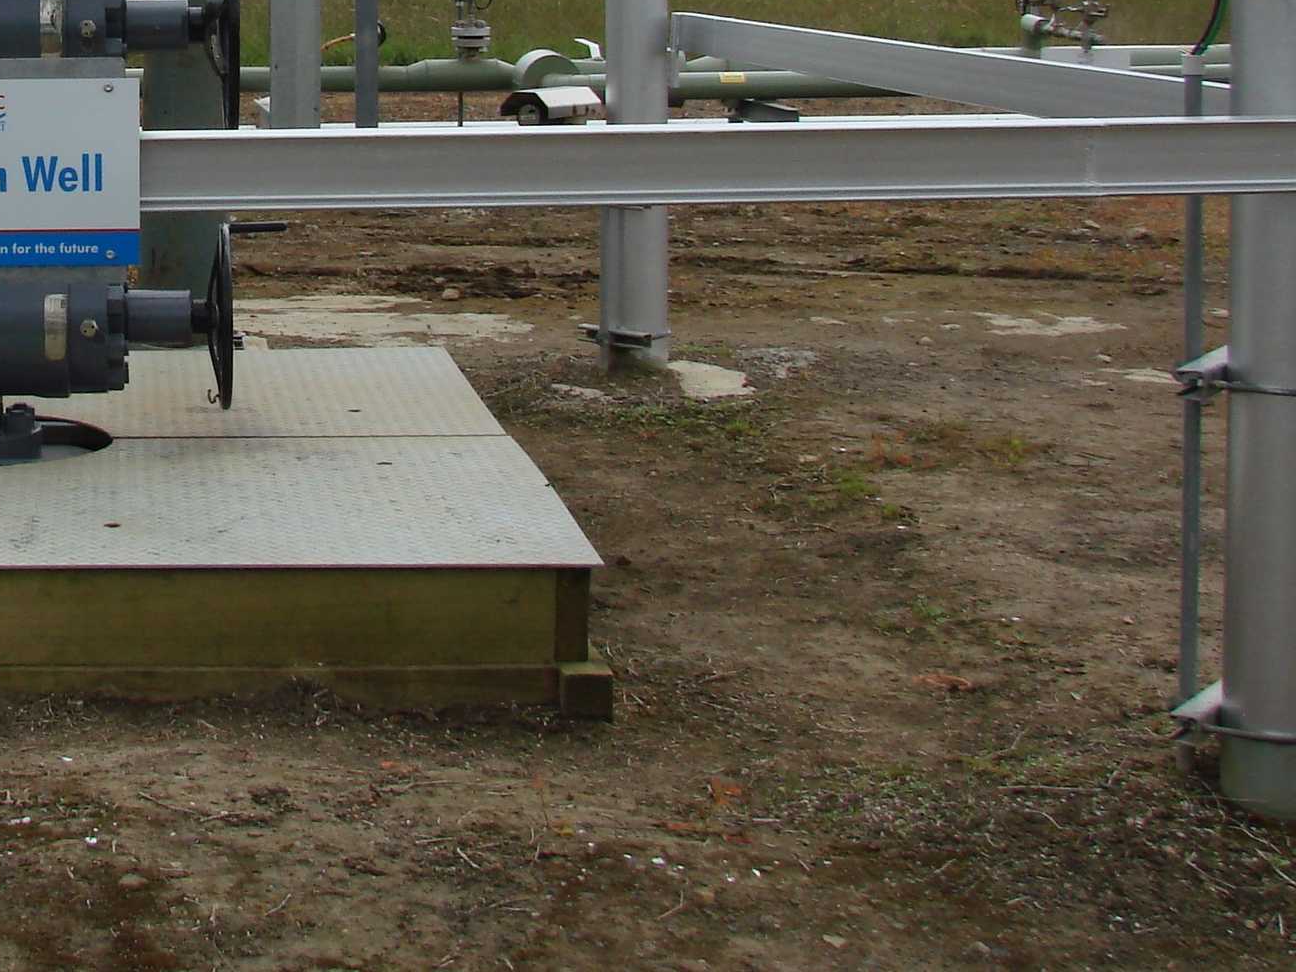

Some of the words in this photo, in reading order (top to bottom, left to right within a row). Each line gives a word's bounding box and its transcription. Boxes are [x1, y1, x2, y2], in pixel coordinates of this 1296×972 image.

[22, 153, 104, 193] Well
[12, 242, 32, 255] for
[35, 242, 56, 254] the
[59, 242, 99, 254] future
